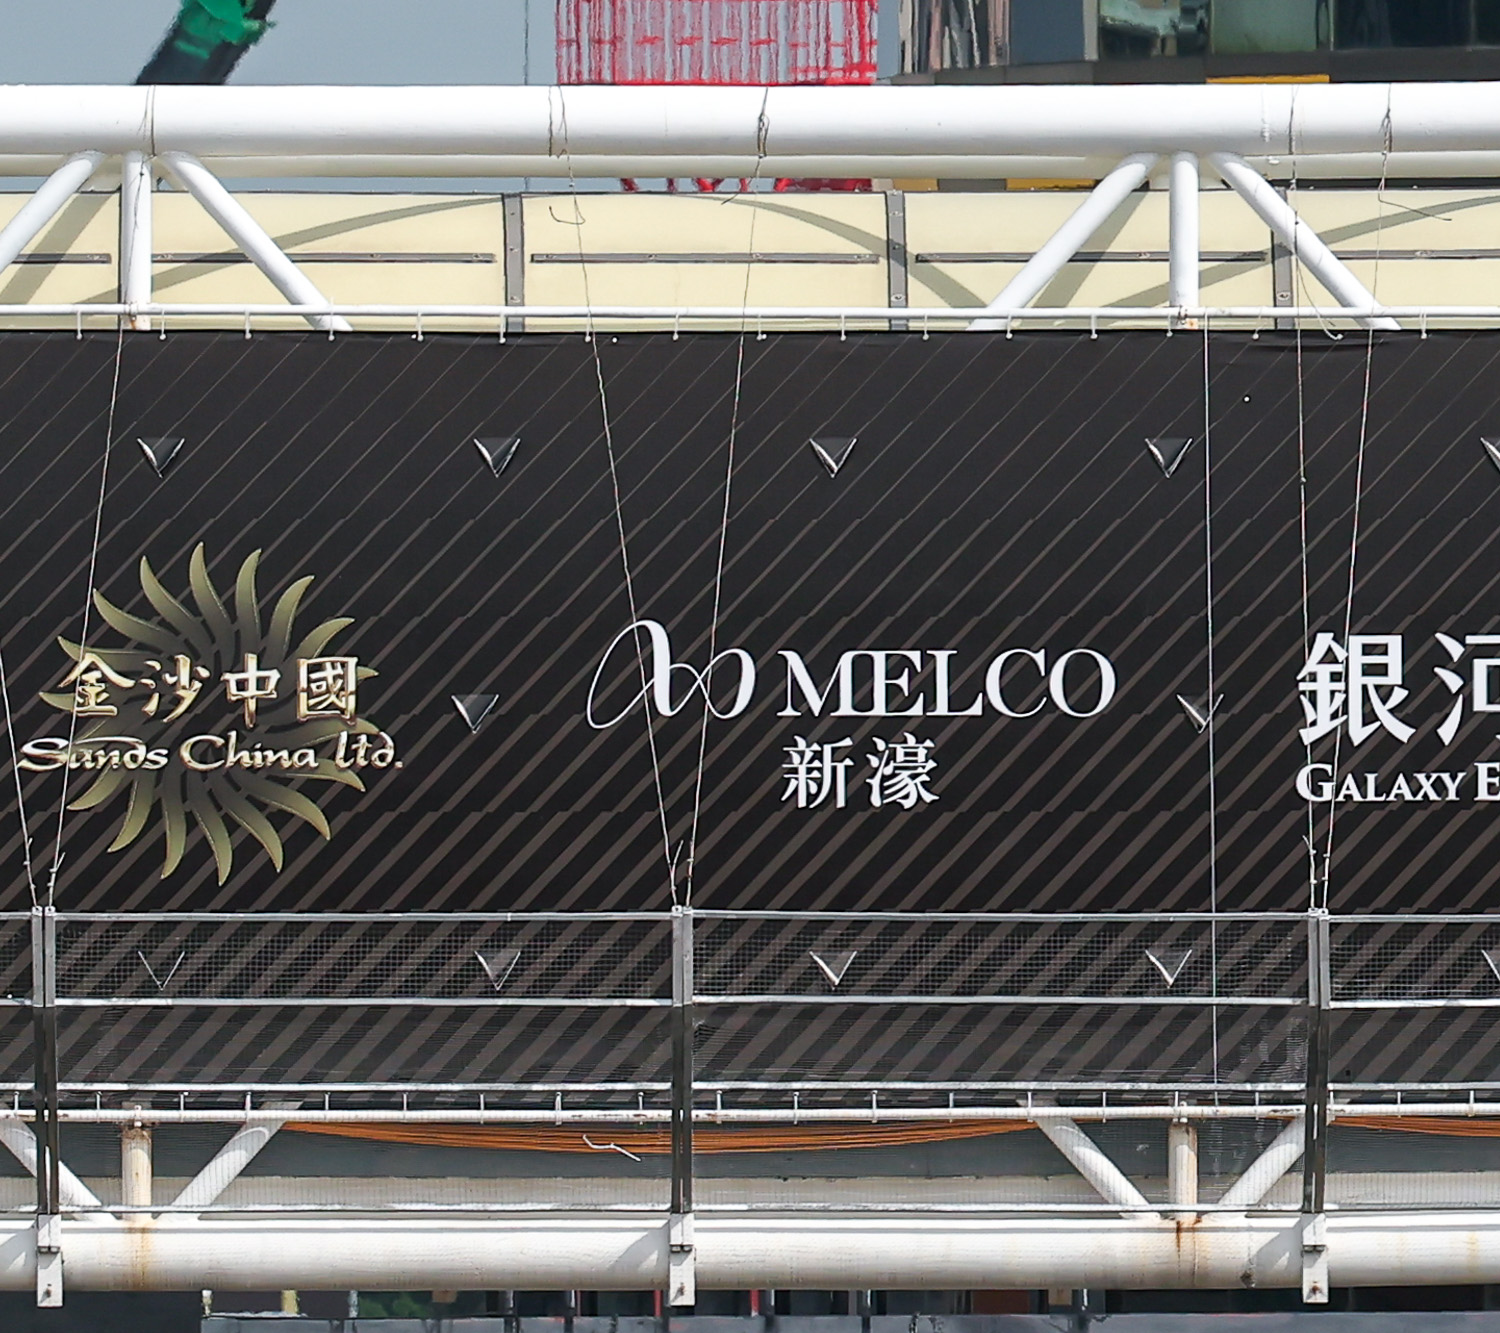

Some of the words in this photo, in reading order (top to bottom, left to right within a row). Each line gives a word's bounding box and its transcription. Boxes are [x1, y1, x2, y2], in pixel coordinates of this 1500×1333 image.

[56, 652, 360, 729] 金沙中國
[776, 648, 1117, 718] MELCO
[16, 735, 169, 773] Sands
[179, 730, 319, 771] China
[780, 732, 941, 810] 新濠
